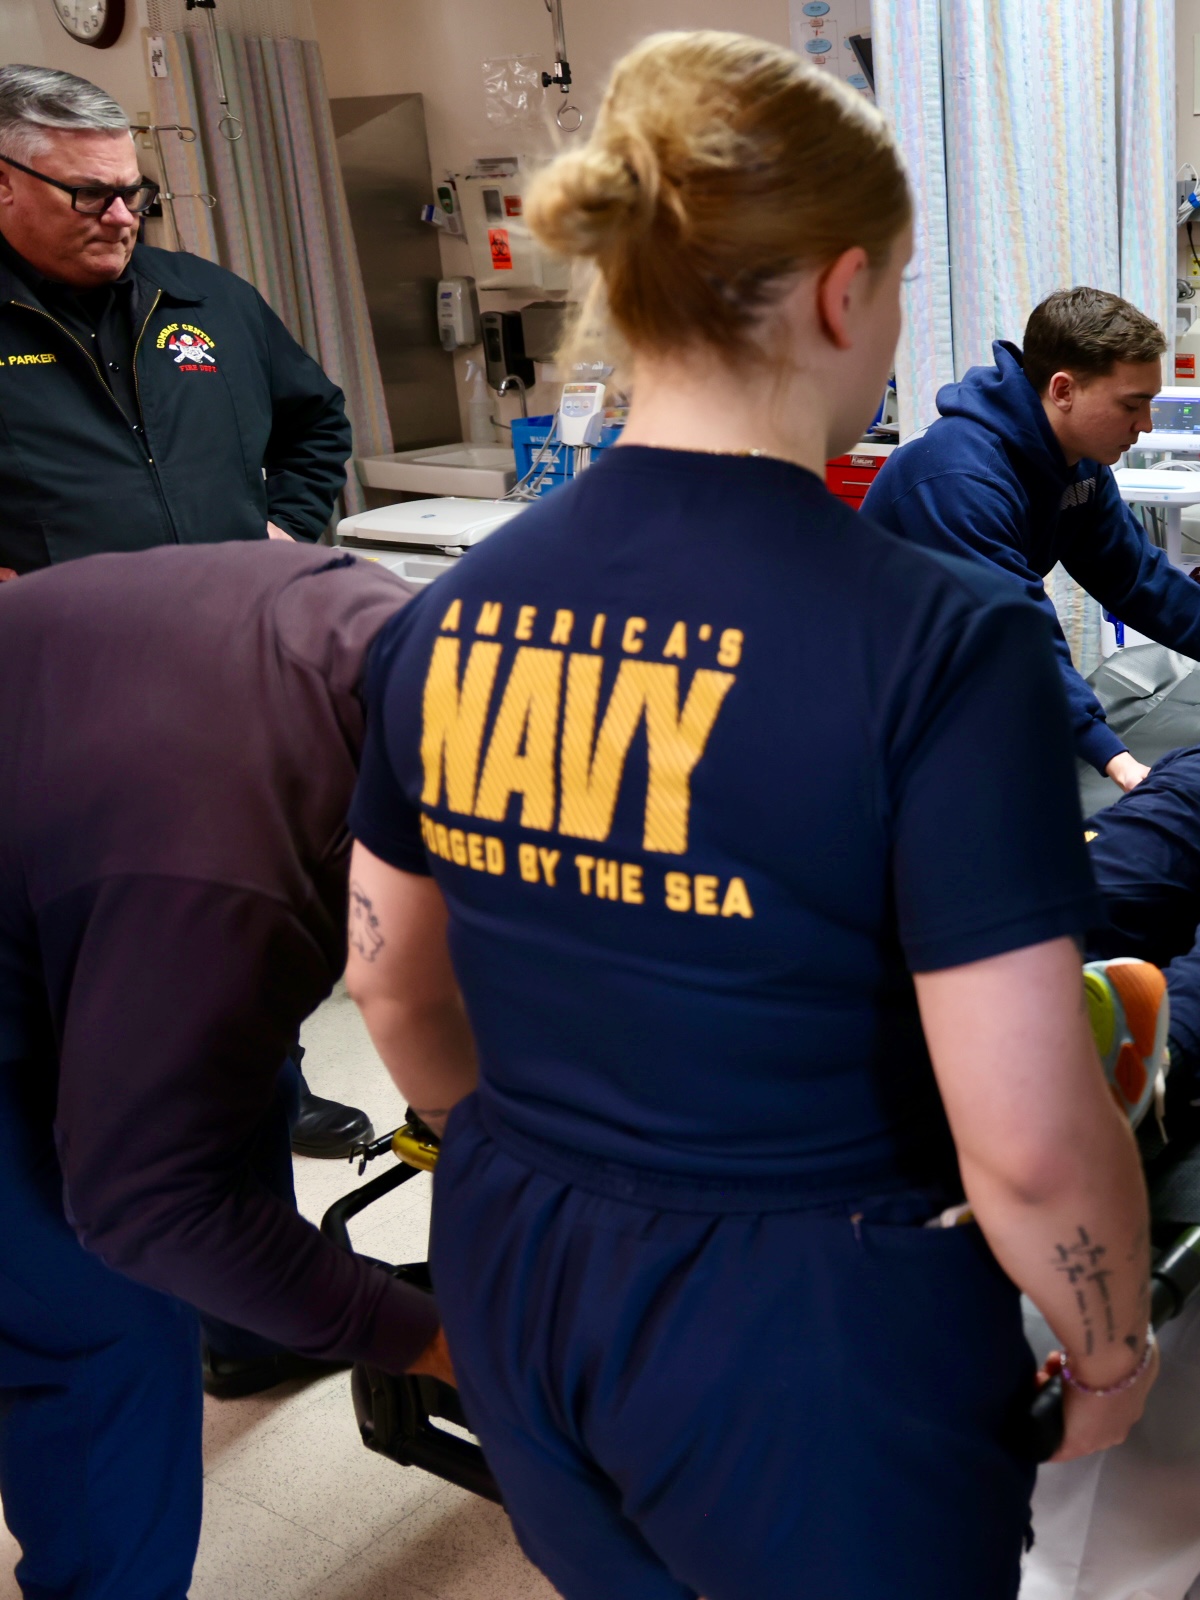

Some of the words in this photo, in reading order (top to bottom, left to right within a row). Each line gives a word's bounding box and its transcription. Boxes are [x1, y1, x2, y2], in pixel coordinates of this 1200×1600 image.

[72, 17, 78, 28] 7
[83, 21, 91, 33] 6
[91, 15, 98, 27] 5
[156, 323, 179, 348] COMBAT
[182, 324, 215, 348] CENTER
[8, 354, 56, 366] PARKER
[179, 364, 198, 372] FIRE
[440, 599, 744, 668] AMERICA'S
[420, 635, 736, 855] NAVY
[518, 842, 561, 887] BY
[574, 854, 645, 905] THE
[665, 871, 754, 919] SEA
